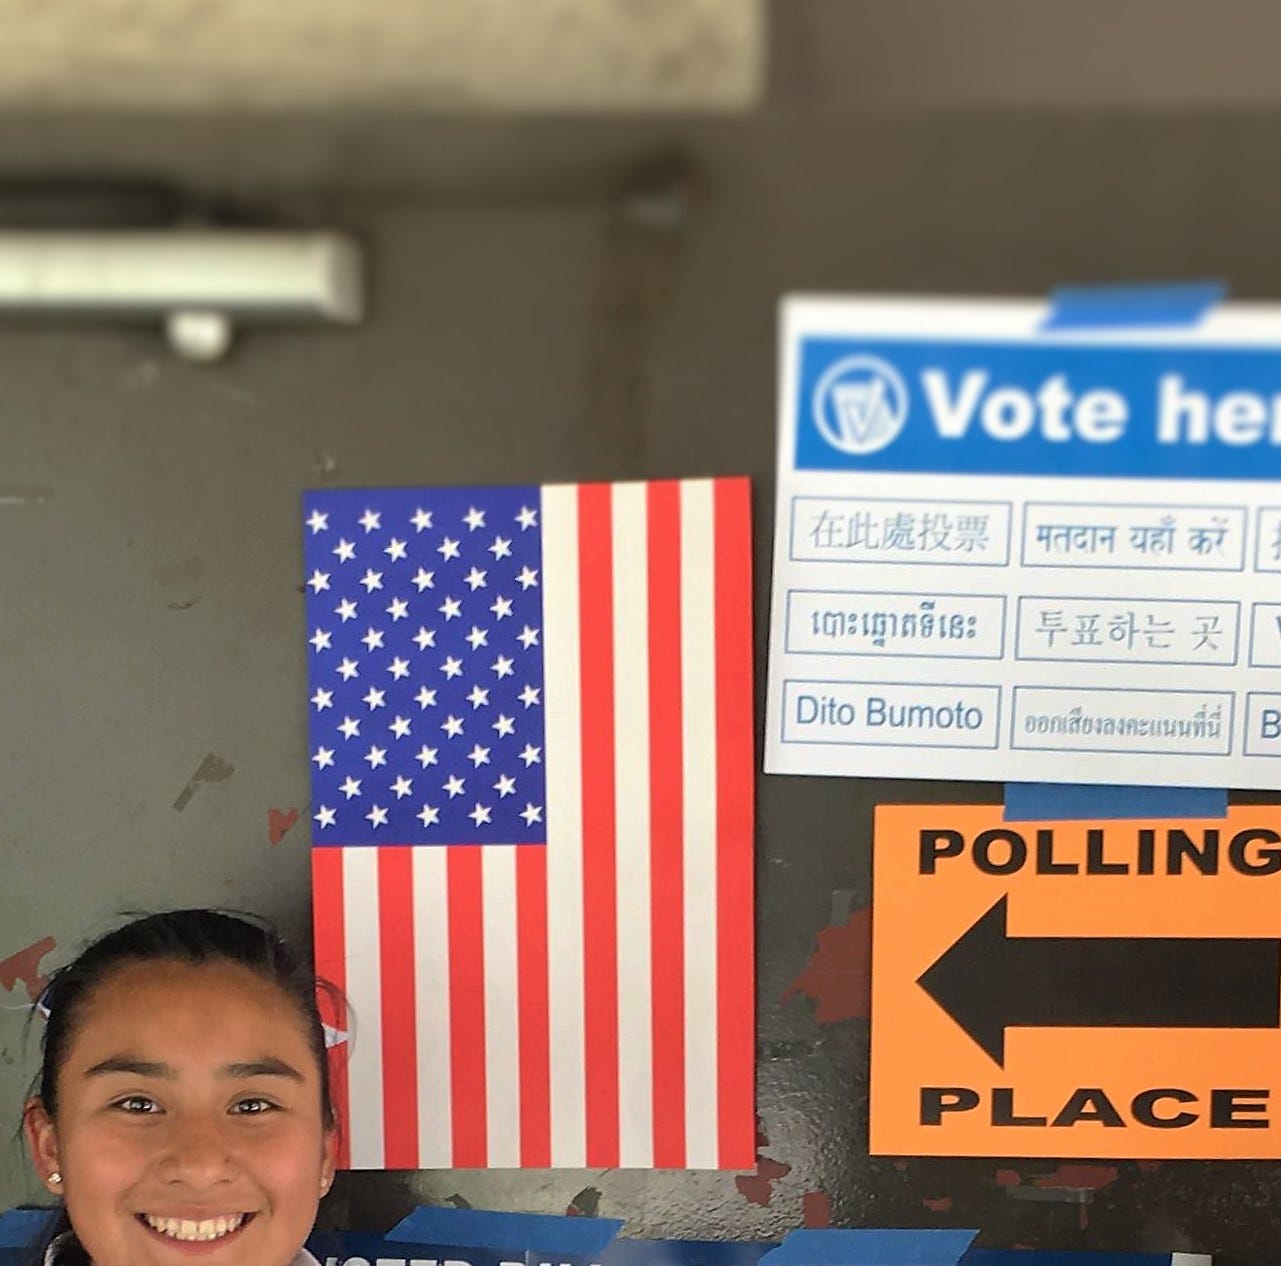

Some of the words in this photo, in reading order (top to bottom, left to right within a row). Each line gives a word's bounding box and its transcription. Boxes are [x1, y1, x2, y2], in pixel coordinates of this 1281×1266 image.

[922, 368, 1129, 442] Vote
[809, 508, 991, 553] 在此處投票
[1036, 524, 1118, 554] मतदान
[1035, 609, 1176, 651] 투표하는
[1191, 614, 1225, 652] 곳
[796, 695, 855, 727] Dito
[866, 697, 984, 731] Bumoto
[919, 1087, 1270, 1130] PLACE
